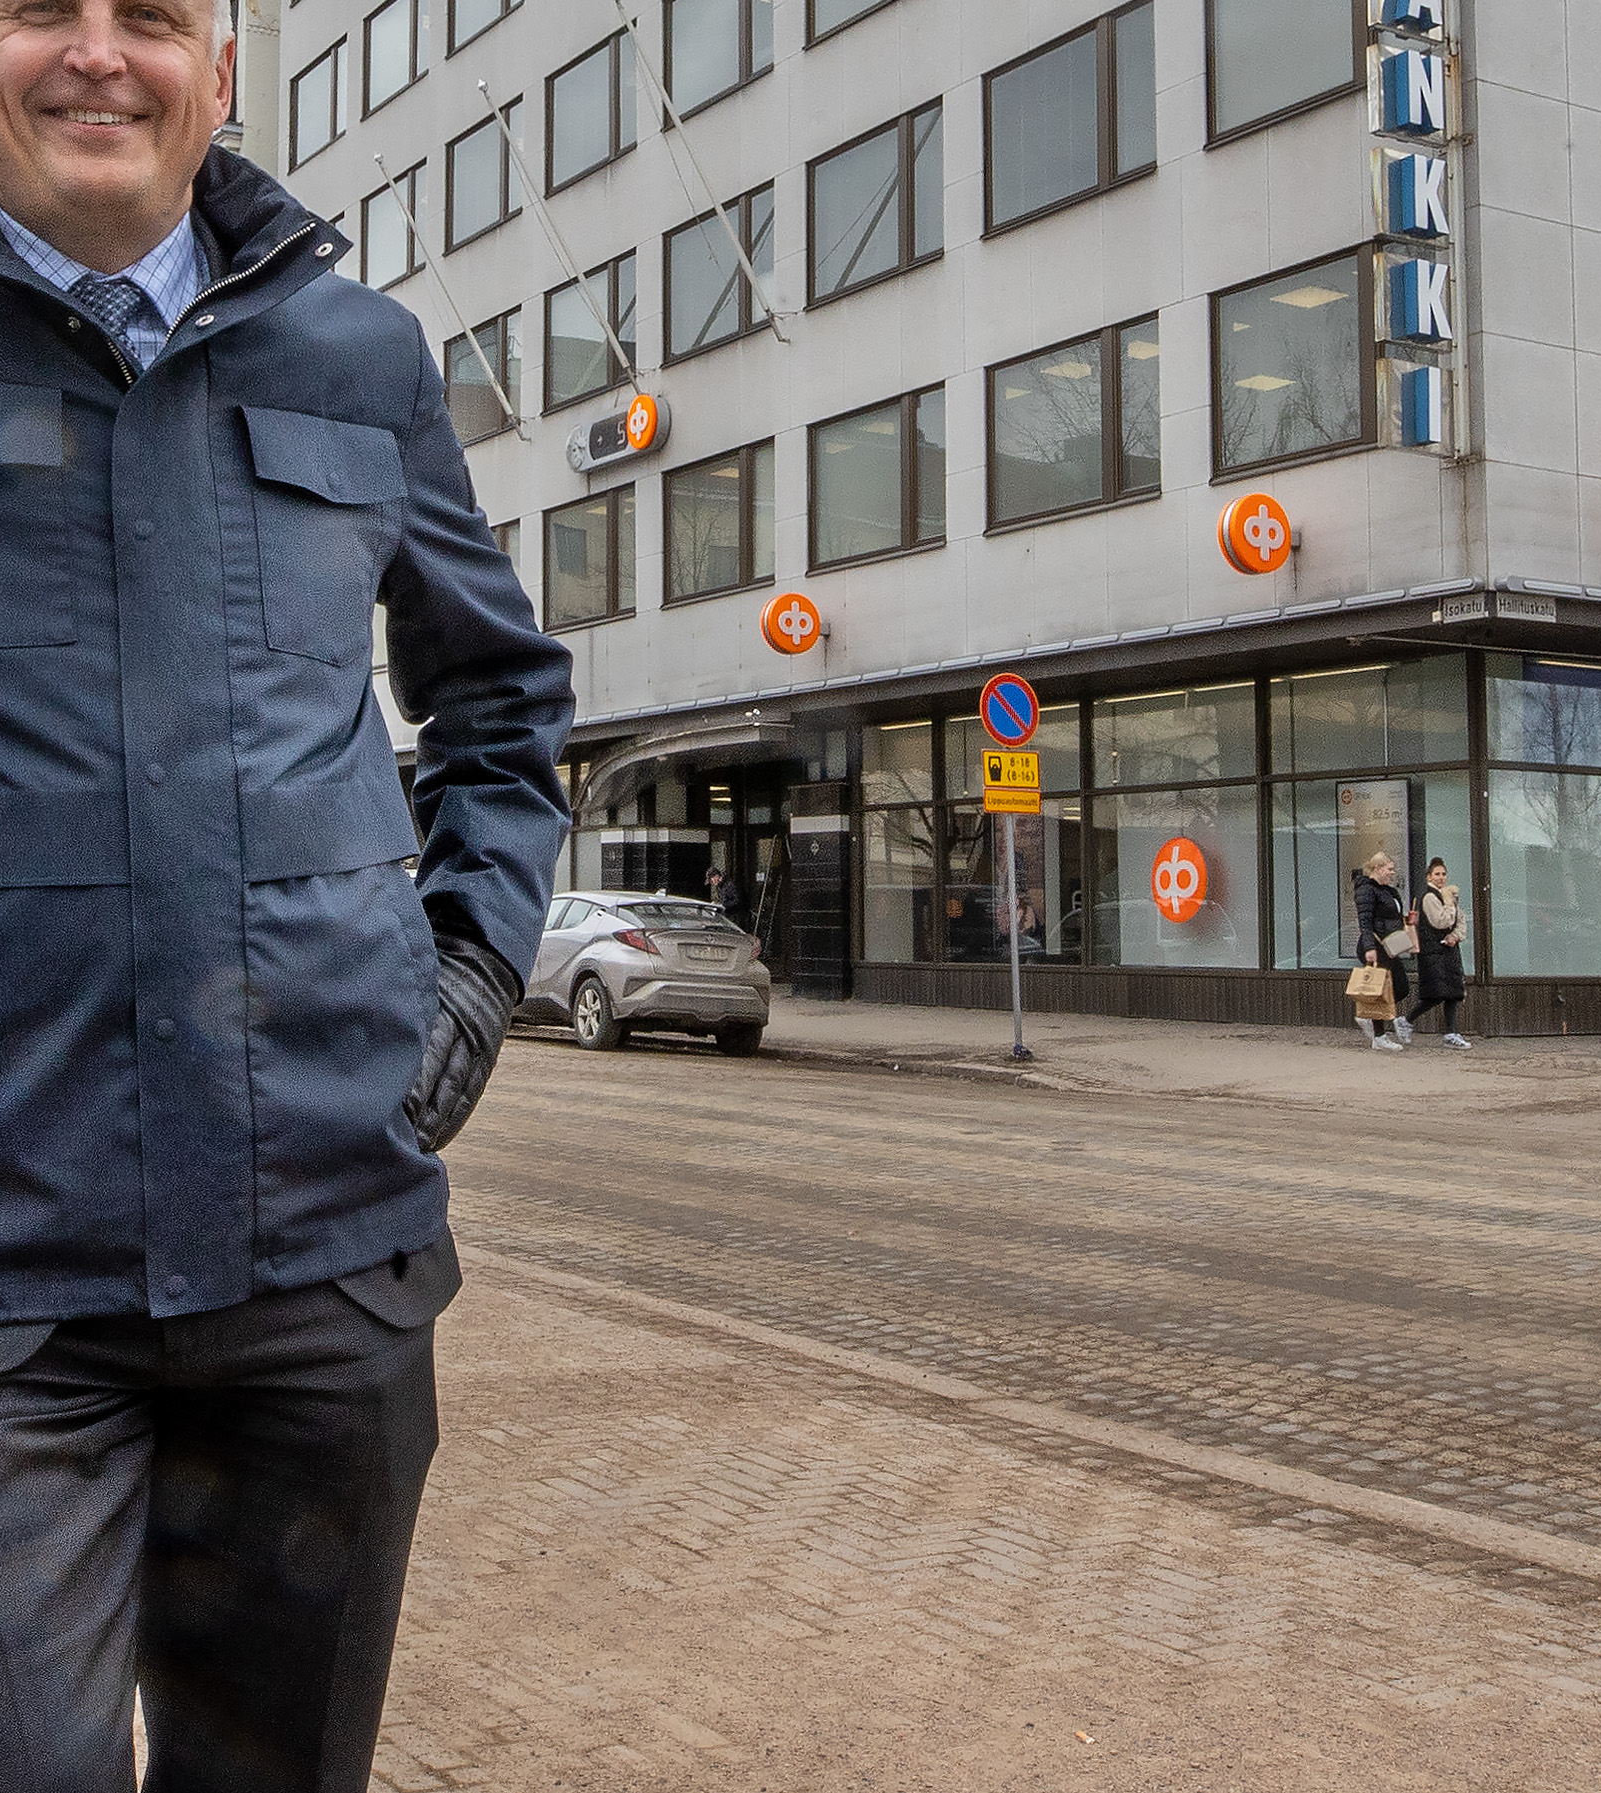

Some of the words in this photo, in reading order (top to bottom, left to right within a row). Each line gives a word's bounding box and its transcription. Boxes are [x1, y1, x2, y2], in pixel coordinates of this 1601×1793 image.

[1444, 600, 1484, 617] Isokatu
[1498, 598, 1554, 616] Hallituskatu
[1010, 756, 1030, 768] 8-18
[1007, 769, 1035, 782] (8-16)
